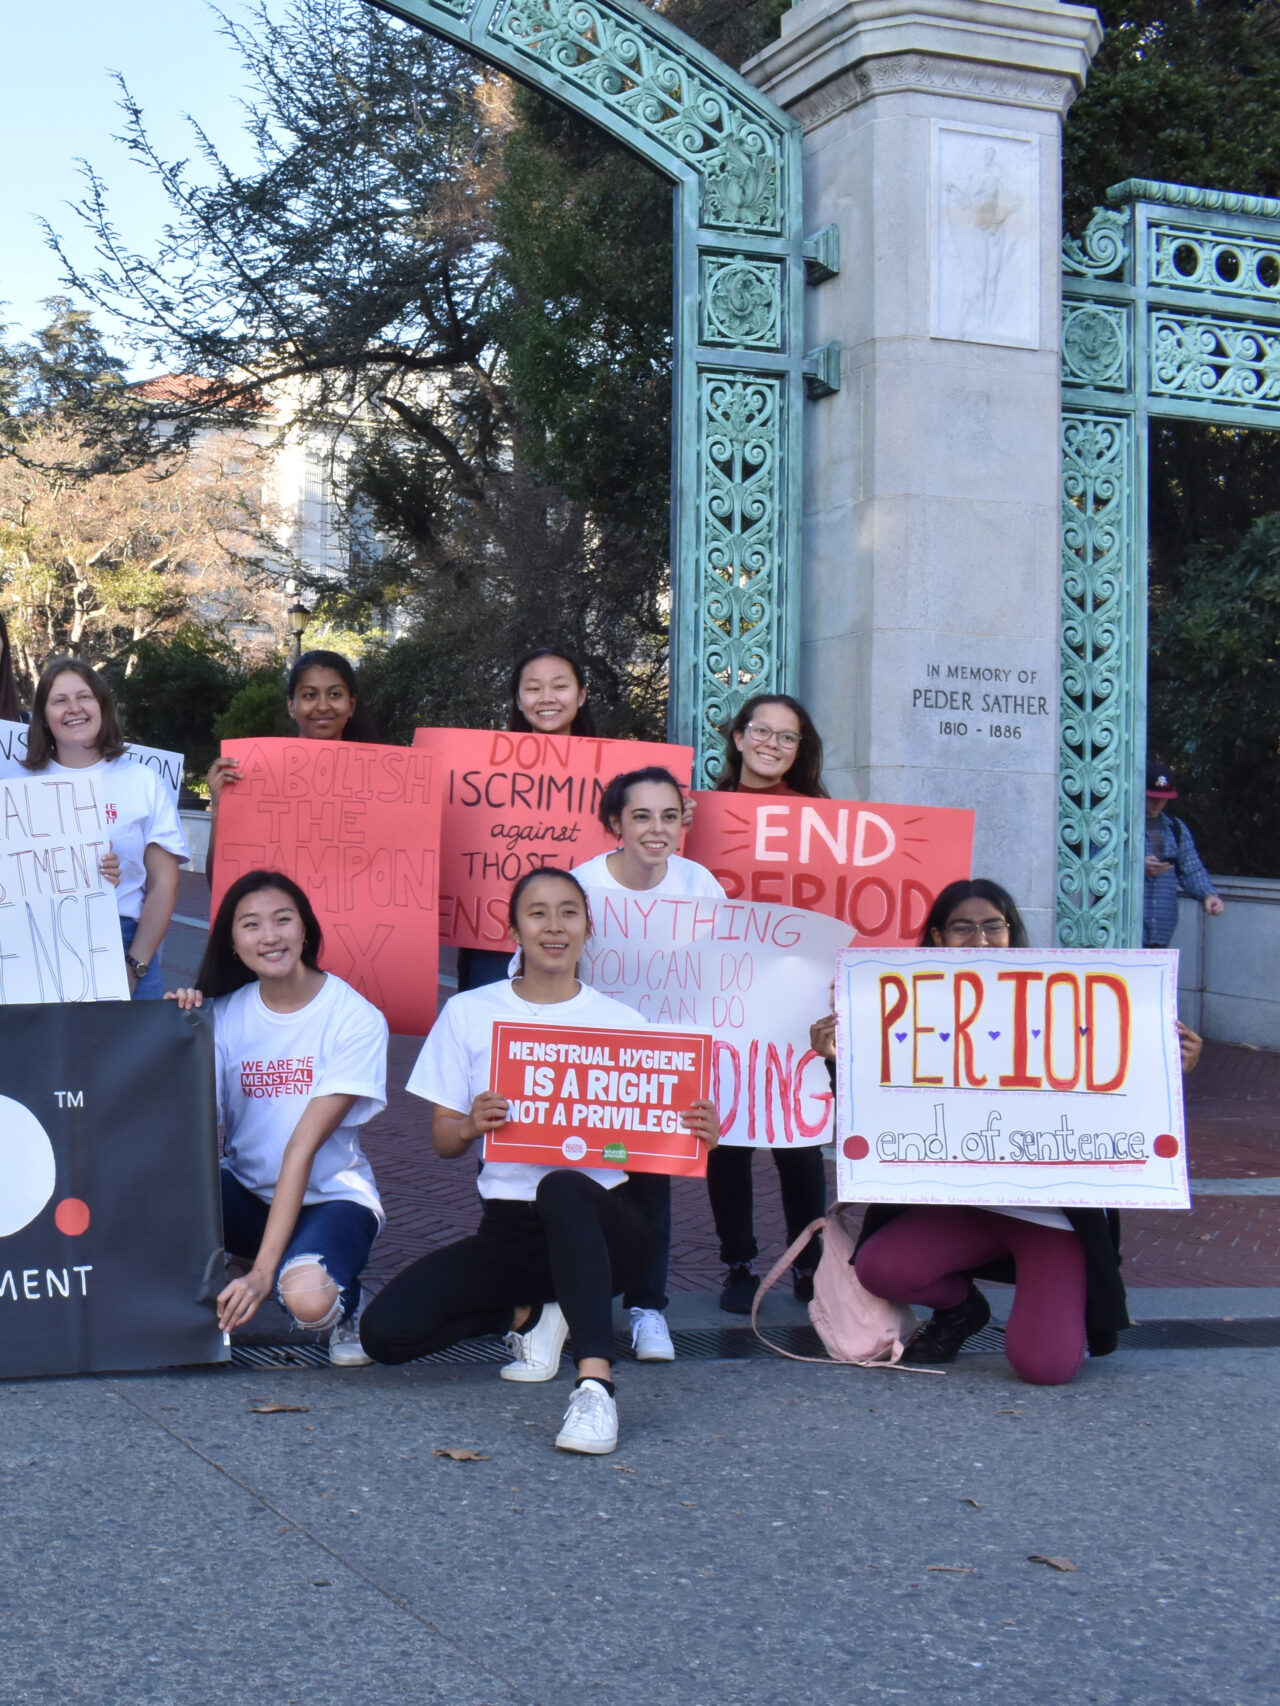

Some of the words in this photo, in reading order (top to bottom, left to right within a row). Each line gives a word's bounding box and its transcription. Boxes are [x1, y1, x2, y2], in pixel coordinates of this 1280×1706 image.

[926, 664, 940, 678] IN
[947, 665, 1012, 682] MEMORY
[1017, 670, 1038, 684] OF
[912, 689, 974, 711] PEDER
[981, 693, 1050, 715] SATHER
[939, 721, 968, 736] 1810
[989, 724, 1022, 739] 1886
[488, 733, 616, 774] DON'T
[230, 744, 433, 804] ABOLISH
[257, 800, 367, 844] THE
[491, 821, 582, 850] against
[755, 805, 897, 867] END
[584, 949, 641, 986] YOU
[646, 950, 702, 990] CAN
[720, 952, 754, 992] DO
[712, 995, 745, 1029] DO
[879, 970, 1132, 1093] PERIOD
[241, 1060, 264, 1072] WE
[266, 1058, 294, 1072] ARE
[509, 1041, 615, 1067] MENSTRUAL
[618, 1048, 696, 1072] HYGIENE
[54, 1089, 84, 1109] TM
[242, 1083, 313, 1099] MOVEENT
[523, 1065, 555, 1097] IS
[560, 1068, 580, 1099] A
[586, 1069, 679, 1105] RIGHT
[506, 1099, 550, 1125] NOT
[552, 1102, 568, 1126] A
[571, 1103, 692, 1135] PRIVILEGE
